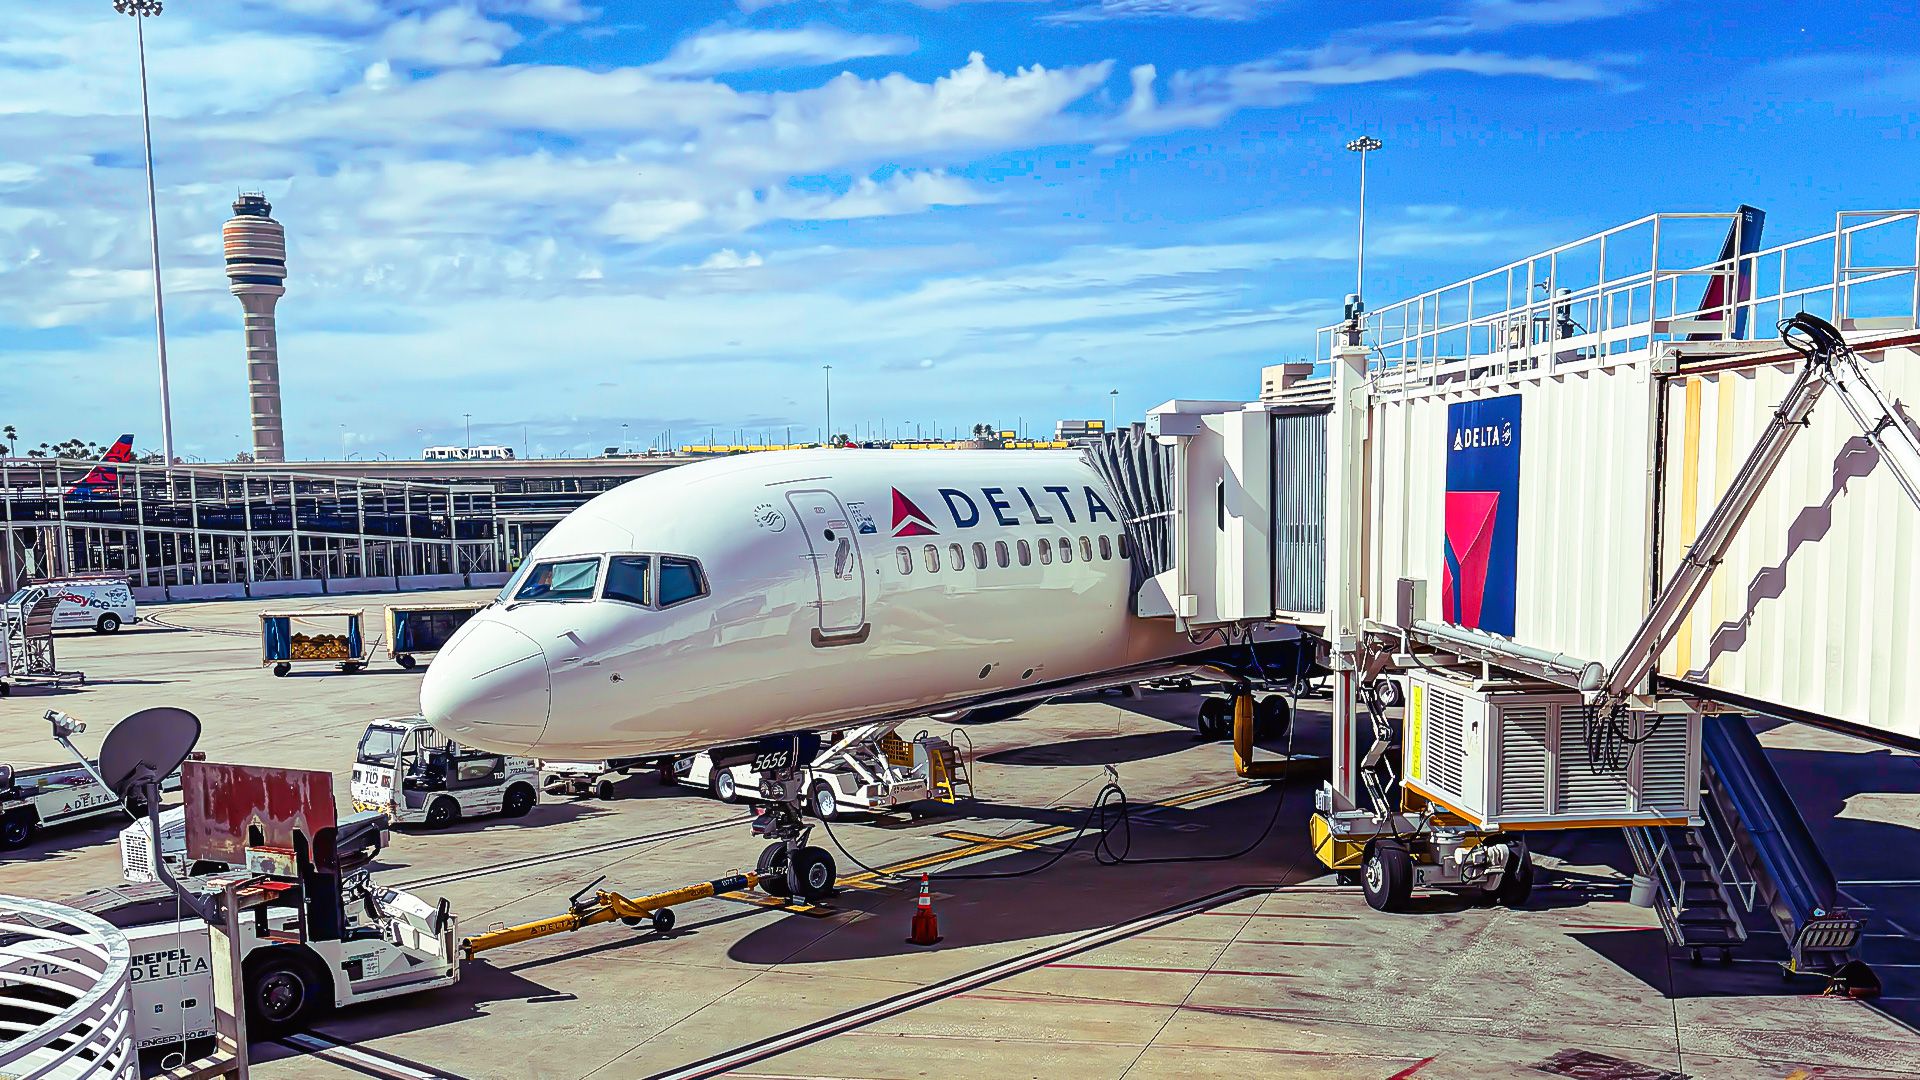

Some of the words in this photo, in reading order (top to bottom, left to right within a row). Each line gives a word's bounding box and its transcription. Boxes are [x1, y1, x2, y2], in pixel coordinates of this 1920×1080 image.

[1465, 426, 1499, 447] DELTA
[938, 486, 1117, 528] DELTA
[753, 751, 788, 770] 5656
[366, 771, 378, 784] TLD
[75, 794, 109, 809] DELTA
[1416, 869, 1425, 884] R
[540, 918, 573, 932] DELTA
[131, 949, 191, 966] REPEL
[130, 957, 208, 981] DELTA
